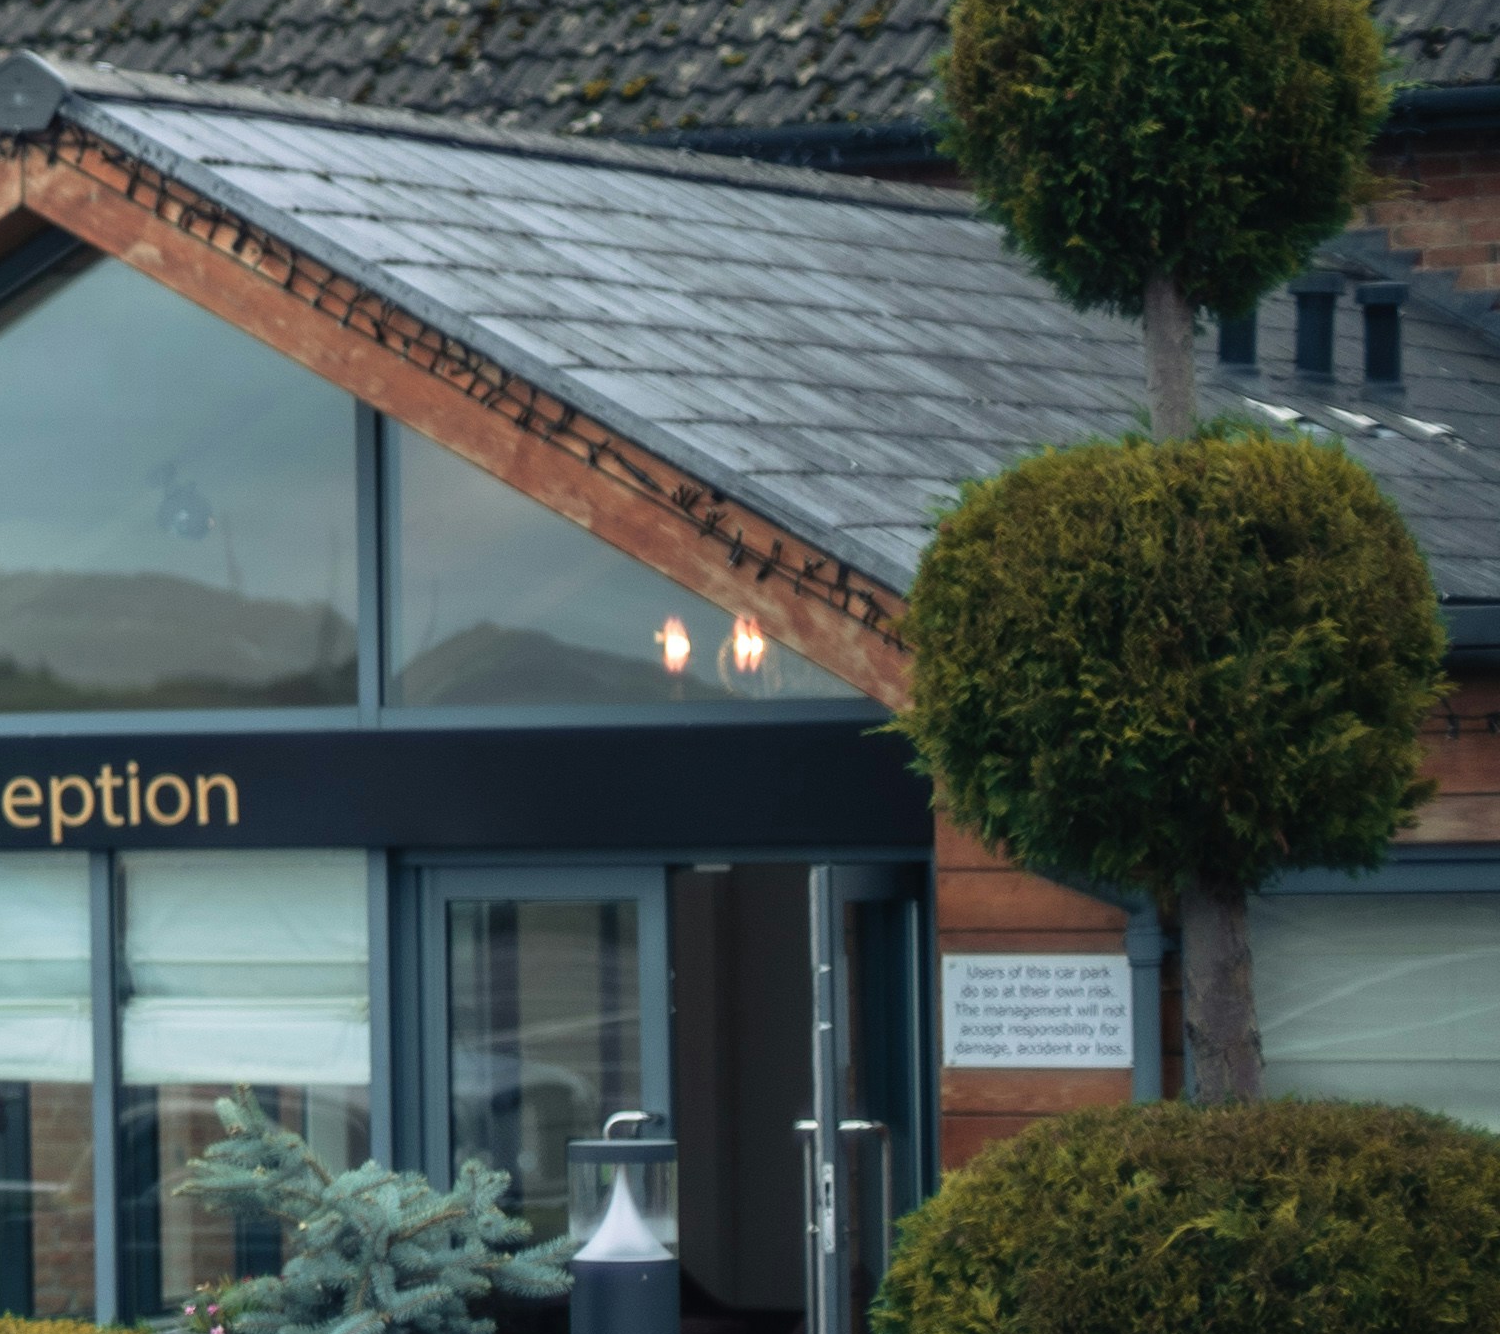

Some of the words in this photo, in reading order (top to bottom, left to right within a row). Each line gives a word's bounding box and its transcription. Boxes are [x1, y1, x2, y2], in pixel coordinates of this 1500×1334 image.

[966, 965, 1005, 979] Users
[1007, 966, 1021, 979] of
[1025, 965, 1051, 979] this
[1054, 968, 1077, 979] car
[1079, 966, 1112, 981] park
[960, 985, 980, 998] do
[981, 986, 1000, 998] so
[1001, 985, 1016, 998] at
[1018, 985, 1051, 998] their
[1053, 986, 1085, 998] own
[954, 1001, 981, 1017] The
[982, 1004, 1072, 1020] management
[1074, 1002, 1100, 1017] will
[1101, 1004, 1125, 1017] not
[960, 1023, 1004, 1038] accept
[1006, 1022, 1096, 1038] responsibility
[1099, 1021, 1120, 1036] for
[1015, 1041, 1073, 1056] accident
[1074, 1044, 1091, 1056] or
